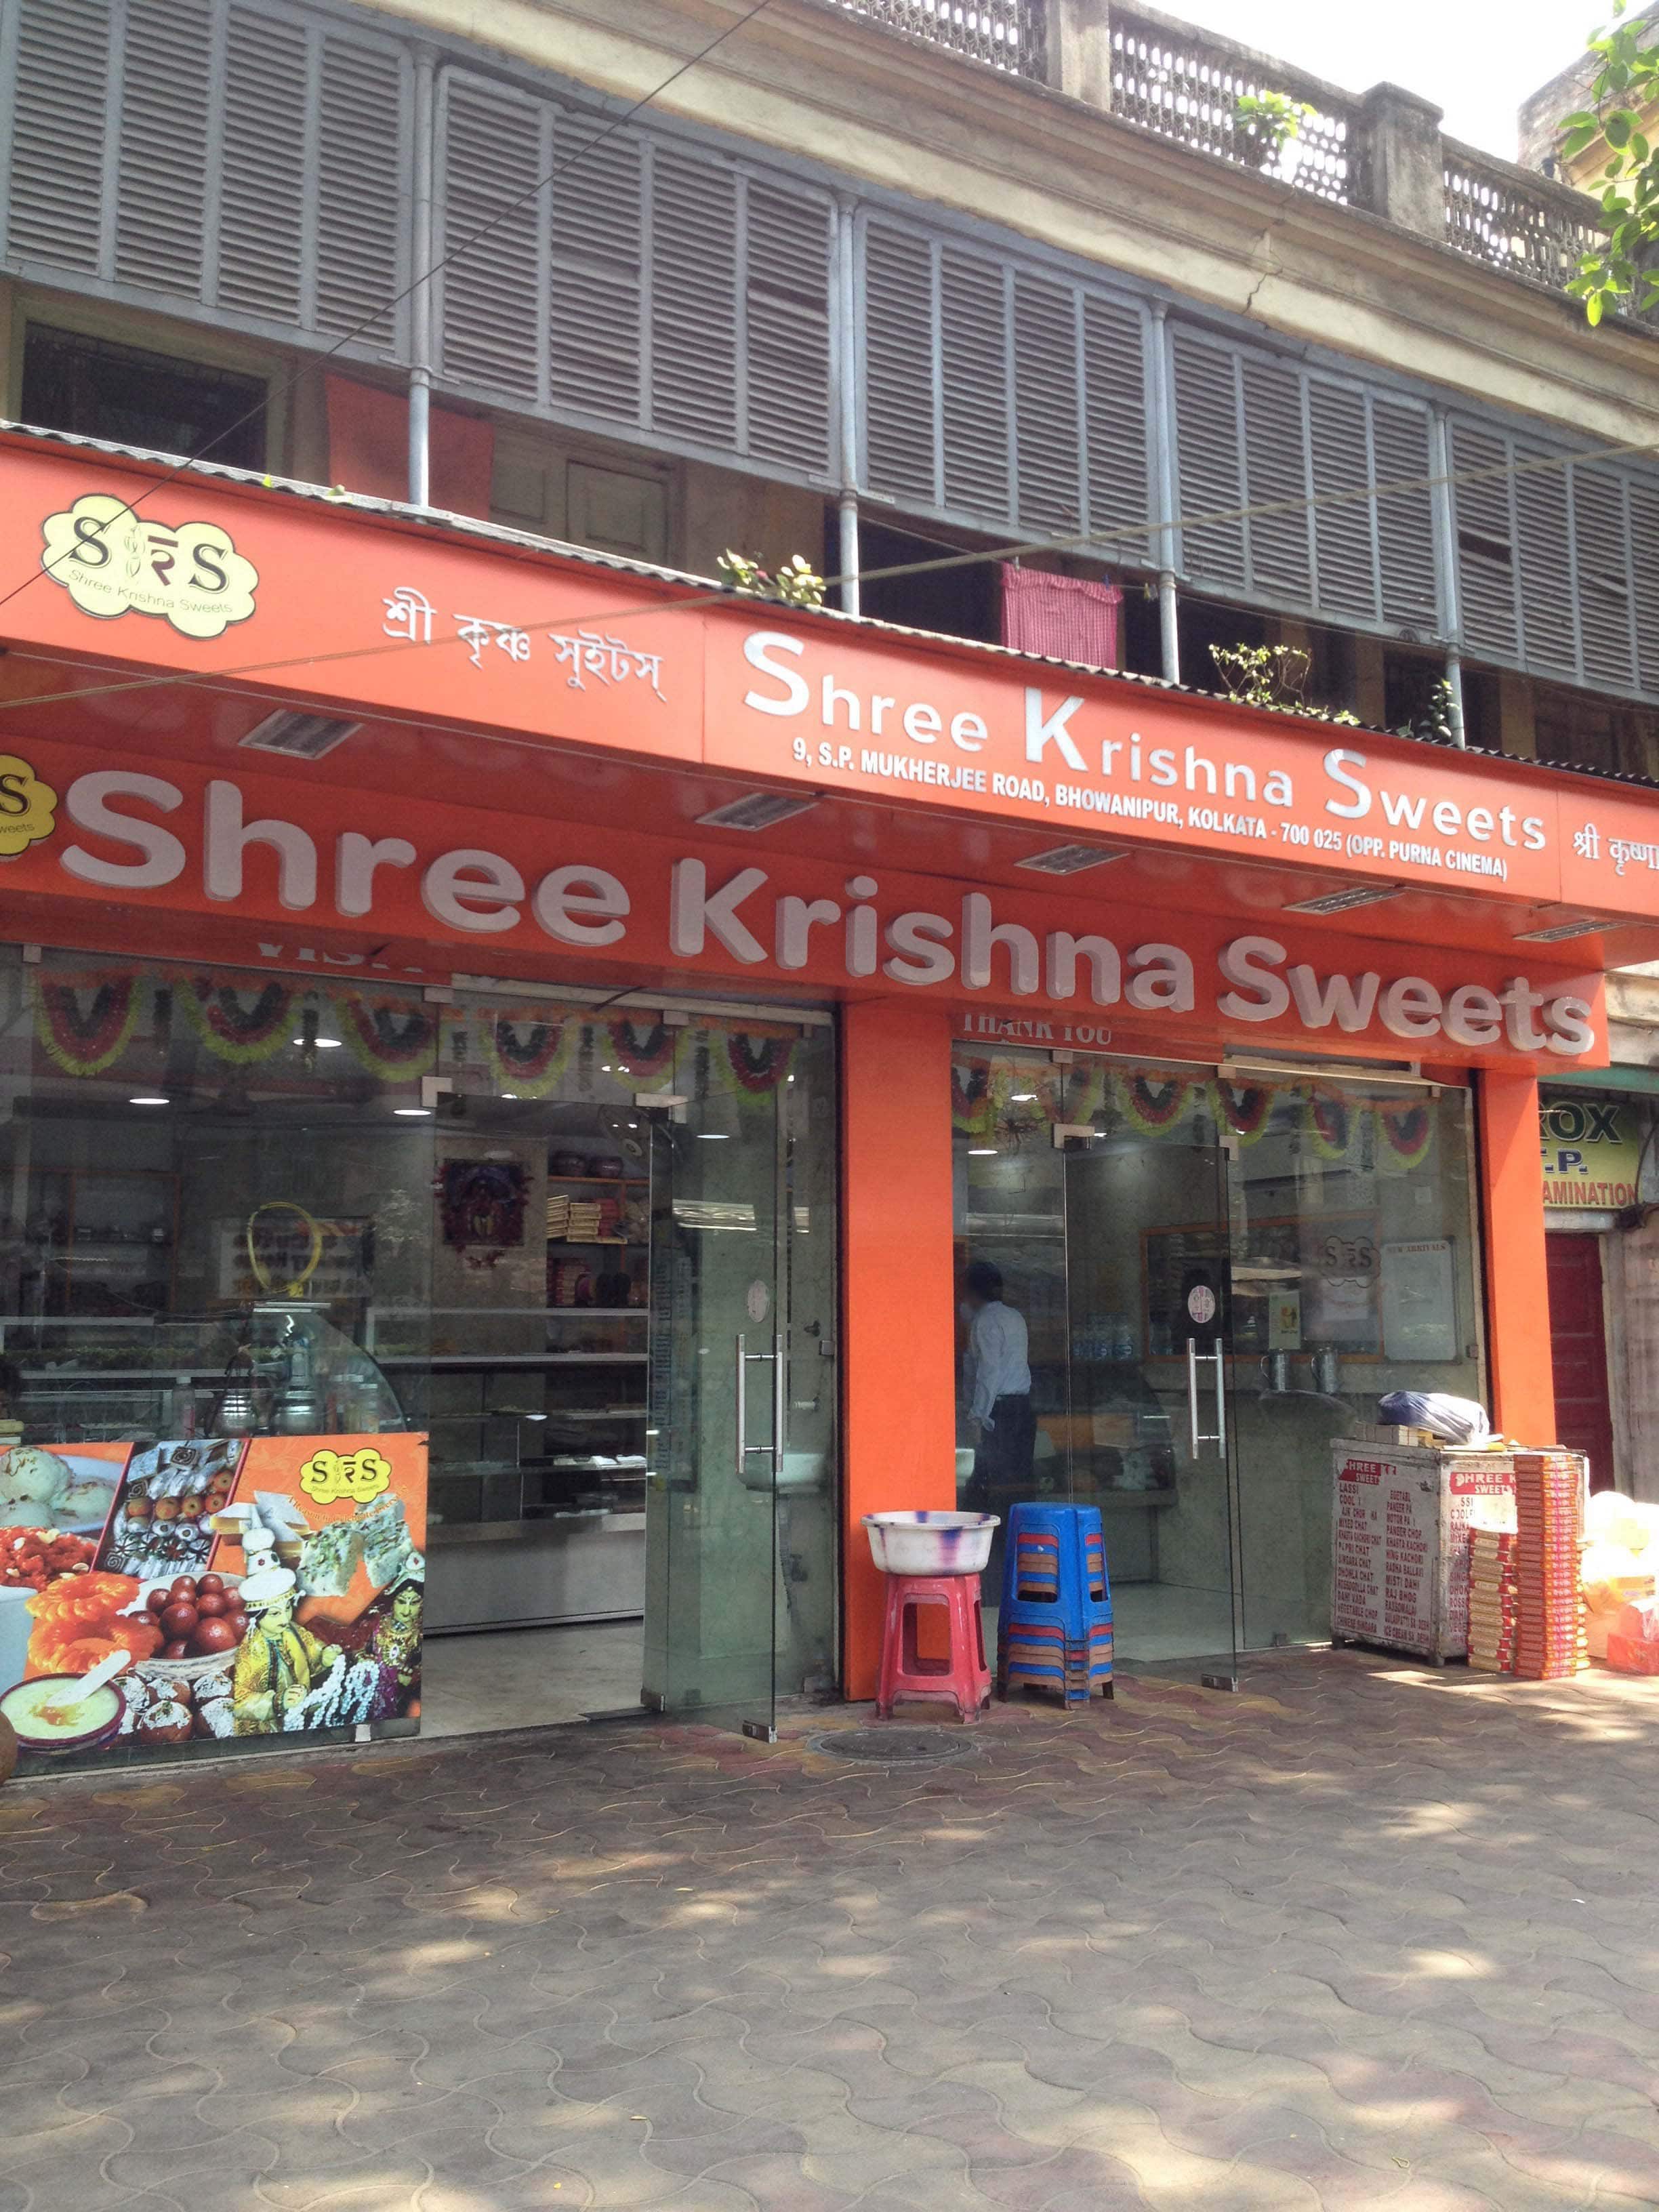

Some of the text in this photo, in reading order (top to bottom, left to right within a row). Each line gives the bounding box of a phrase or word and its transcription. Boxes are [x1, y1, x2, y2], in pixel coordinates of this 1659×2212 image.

[68, 569, 233, 614] Shree Krishna Sweets
[743, 630, 1547, 851] Shree Krishna Sweets
[0, 823, 35, 834] weets
[792, 737, 813, 767] 9,
[818, 741, 855, 771] S.P.
[861, 750, 987, 793] MUKHERJEE
[992, 771, 1050, 807] ROAD,
[1054, 783, 1184, 829] BHOWANIPUR,
[1187, 807, 1267, 839] KOLKATA
[1313, 828, 1343, 852] 025
[1346, 833, 1384, 859] (OPP.
[1389, 840, 1443, 867] PURNA
[1445, 849, 1509, 882] CINEMA)
[1573, 823, 1601, 859] श्री
[60, 770, 1595, 1055] Shree Krishna Sweets
[1542, 1181, 1636, 1206] AMINATION
